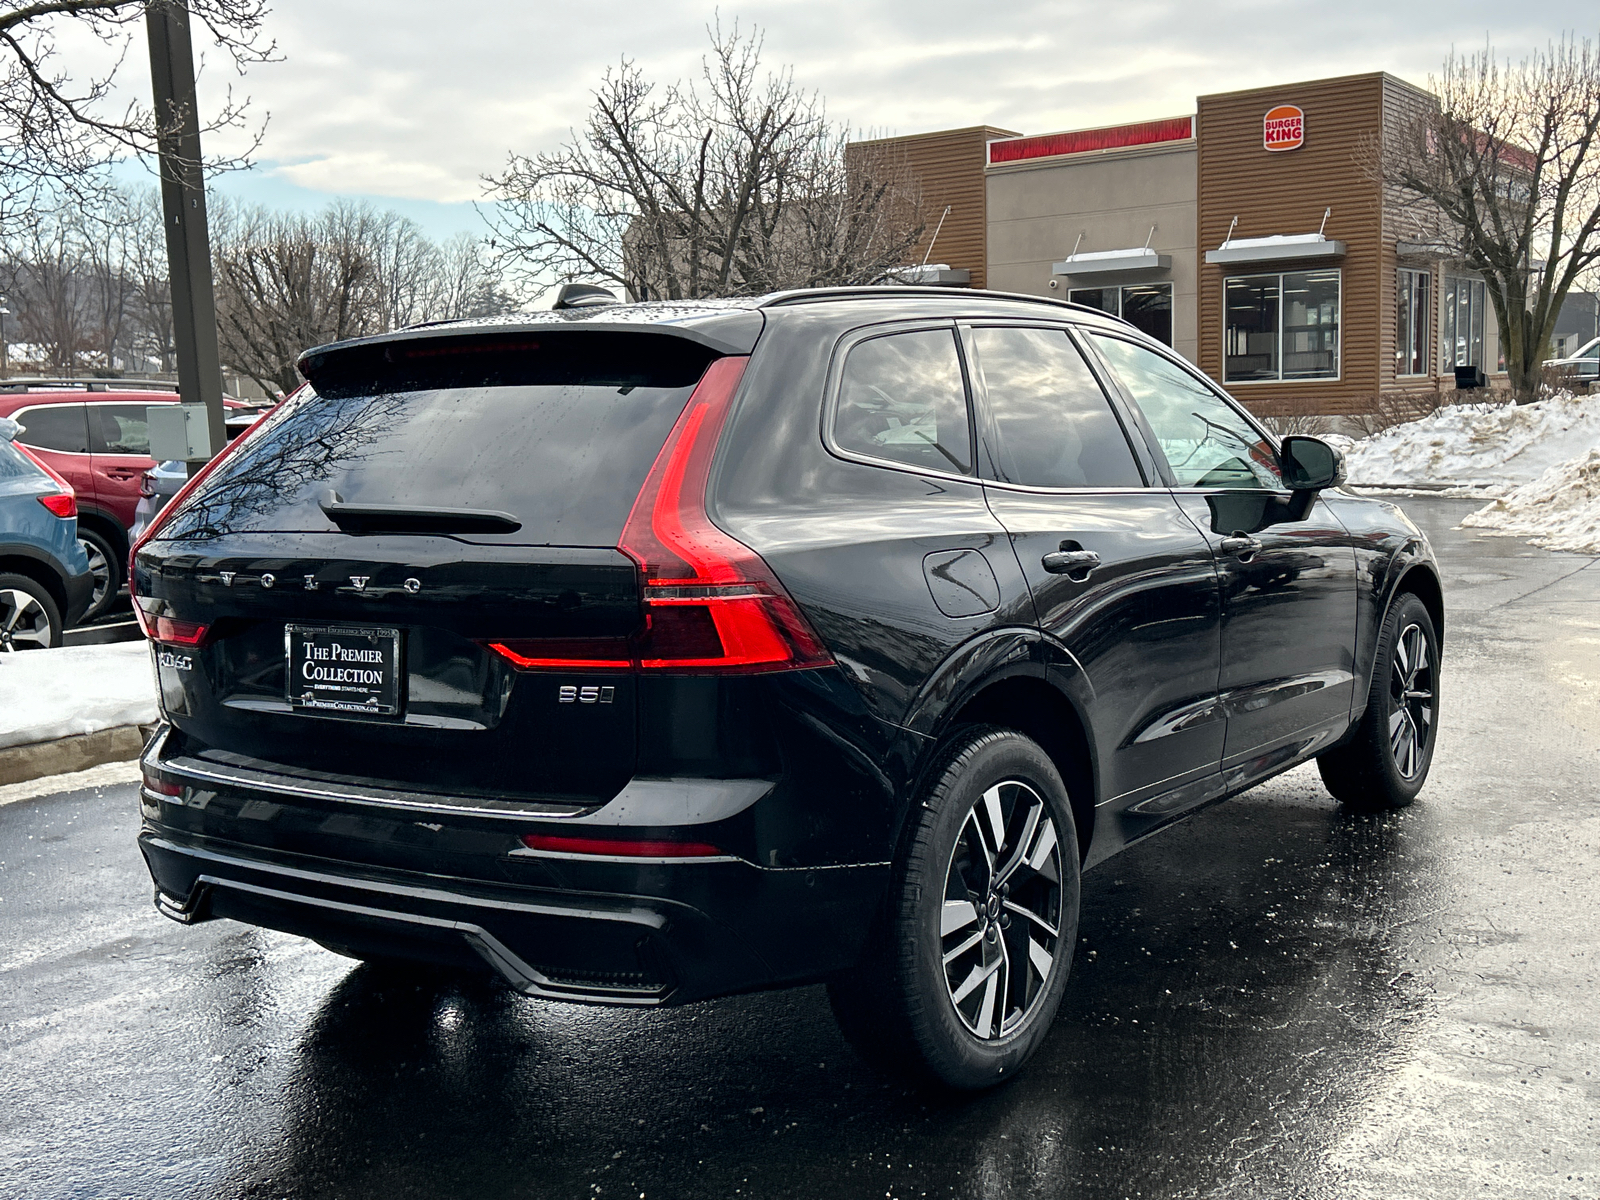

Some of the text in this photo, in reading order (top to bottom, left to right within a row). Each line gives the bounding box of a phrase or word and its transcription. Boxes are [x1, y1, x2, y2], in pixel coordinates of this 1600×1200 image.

[1265, 117, 1302, 130] BURGER
[1265, 126, 1302, 142] KING
[219, 571, 421, 594] VOLVO
[294, 625, 392, 637] AUTOMOTIVE EXCELLENCE SINCE 1995
[303, 641, 383, 664] THE PREMIER
[302, 661, 383, 685] COLLECTION
[559, 685, 599, 704] B5
